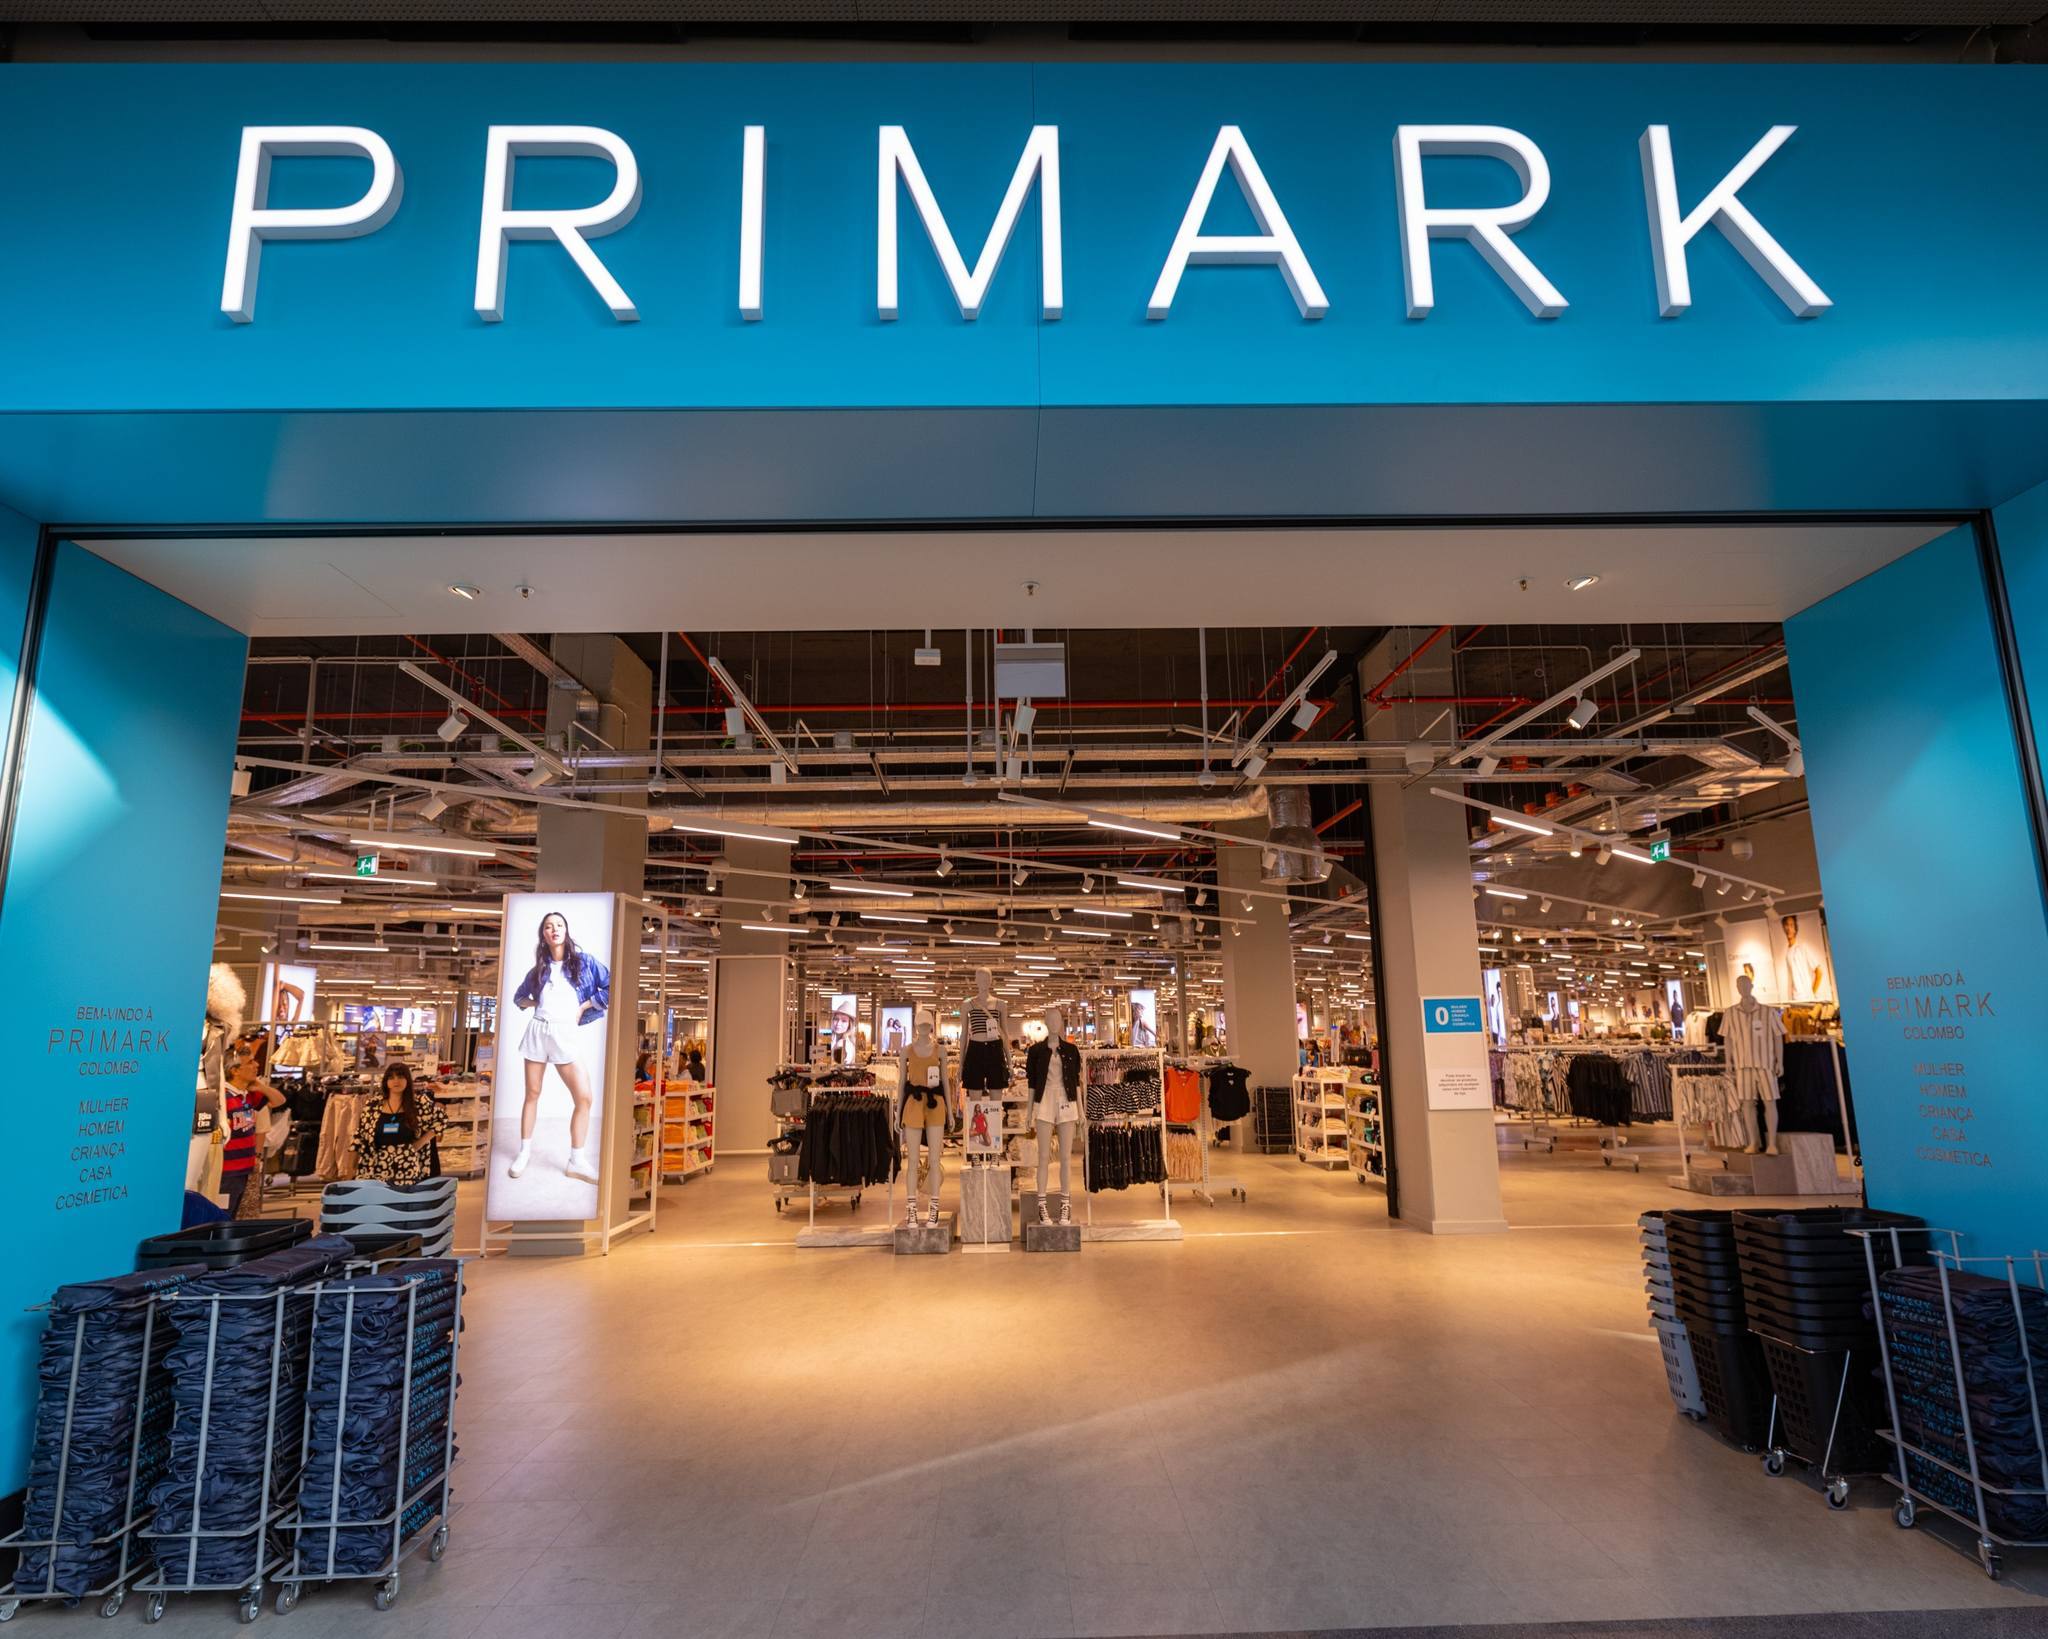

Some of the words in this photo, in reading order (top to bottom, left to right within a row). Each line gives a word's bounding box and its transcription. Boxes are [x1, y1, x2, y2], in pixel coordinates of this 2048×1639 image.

[220, 124, 1835, 324] PRIMARK
[1887, 973, 1953, 990] BEM-VINDO
[76, 1006, 143, 1022] BEM-VINDO
[1871, 992, 1997, 1020] PRIMARK
[48, 1028, 170, 1054] PRIMARK
[1903, 1025, 1965, 1041] COLOMBO
[79, 1060, 139, 1076] COLOMBO
[79, 1097, 129, 1114] MULHER
[78, 1120, 124, 1137] HOMEM
[71, 1142, 126, 1161] CRIANÇA
[79, 1165, 112, 1183] CASA
